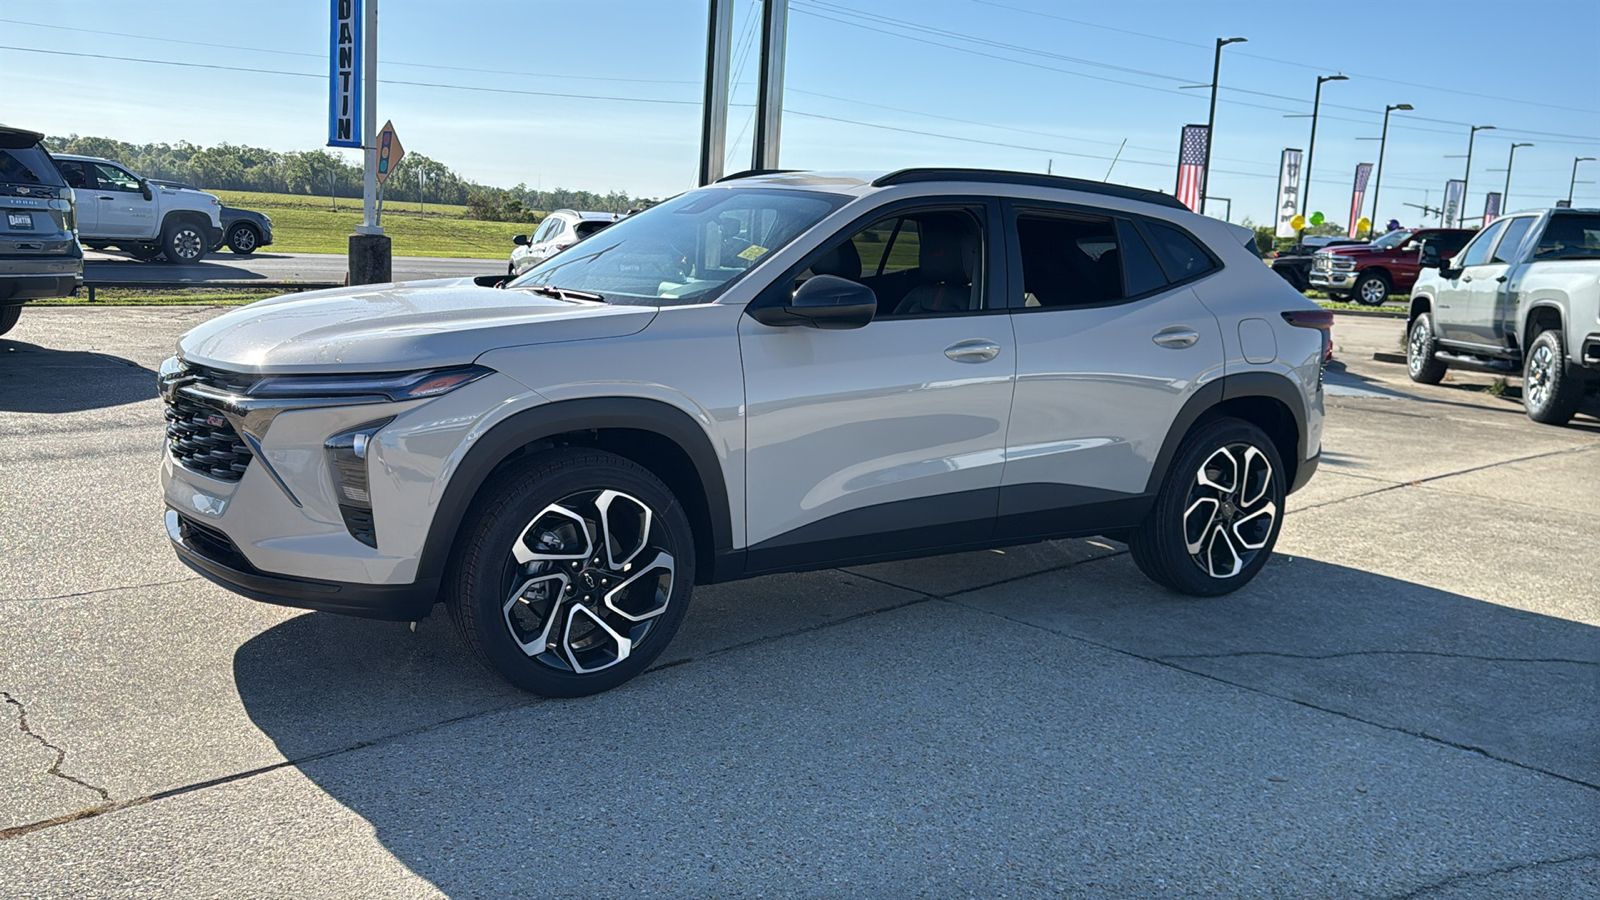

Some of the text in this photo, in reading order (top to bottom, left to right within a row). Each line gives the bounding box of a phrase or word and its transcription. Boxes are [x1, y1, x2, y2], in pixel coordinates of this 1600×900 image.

[338, 0, 352, 140] DANTIN
[8, 215, 32, 225] DANTIN
[1281, 186, 1297, 222] RAM
